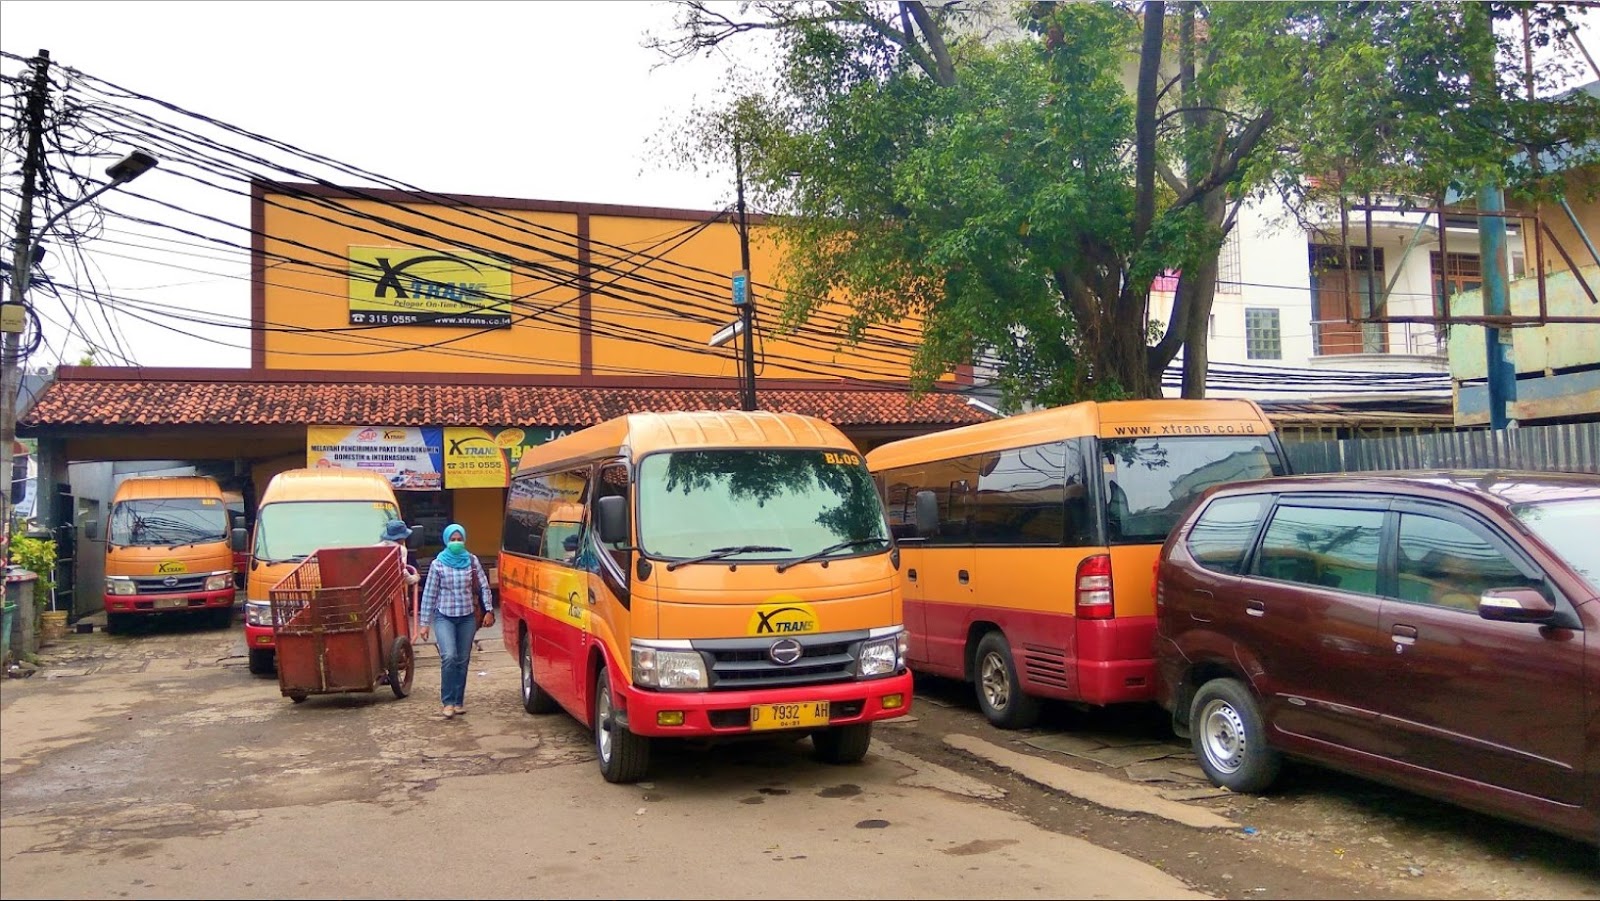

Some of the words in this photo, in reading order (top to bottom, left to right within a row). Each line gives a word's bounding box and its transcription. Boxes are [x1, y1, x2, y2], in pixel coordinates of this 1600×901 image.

[393, 300, 424, 310] Pelopor
[425, 301, 458, 309] On-Time
[368, 314, 388, 323] 315
[358, 430, 378, 441] SAP
[411, 446, 440, 454] DOKUMEN
[459, 461, 475, 469] 315
[478, 461, 502, 469] 0555
[756, 607, 815, 634] XTRANS
[752, 708, 760, 722] D
[773, 705, 799, 720] 7932
[814, 706, 829, 718] AH
